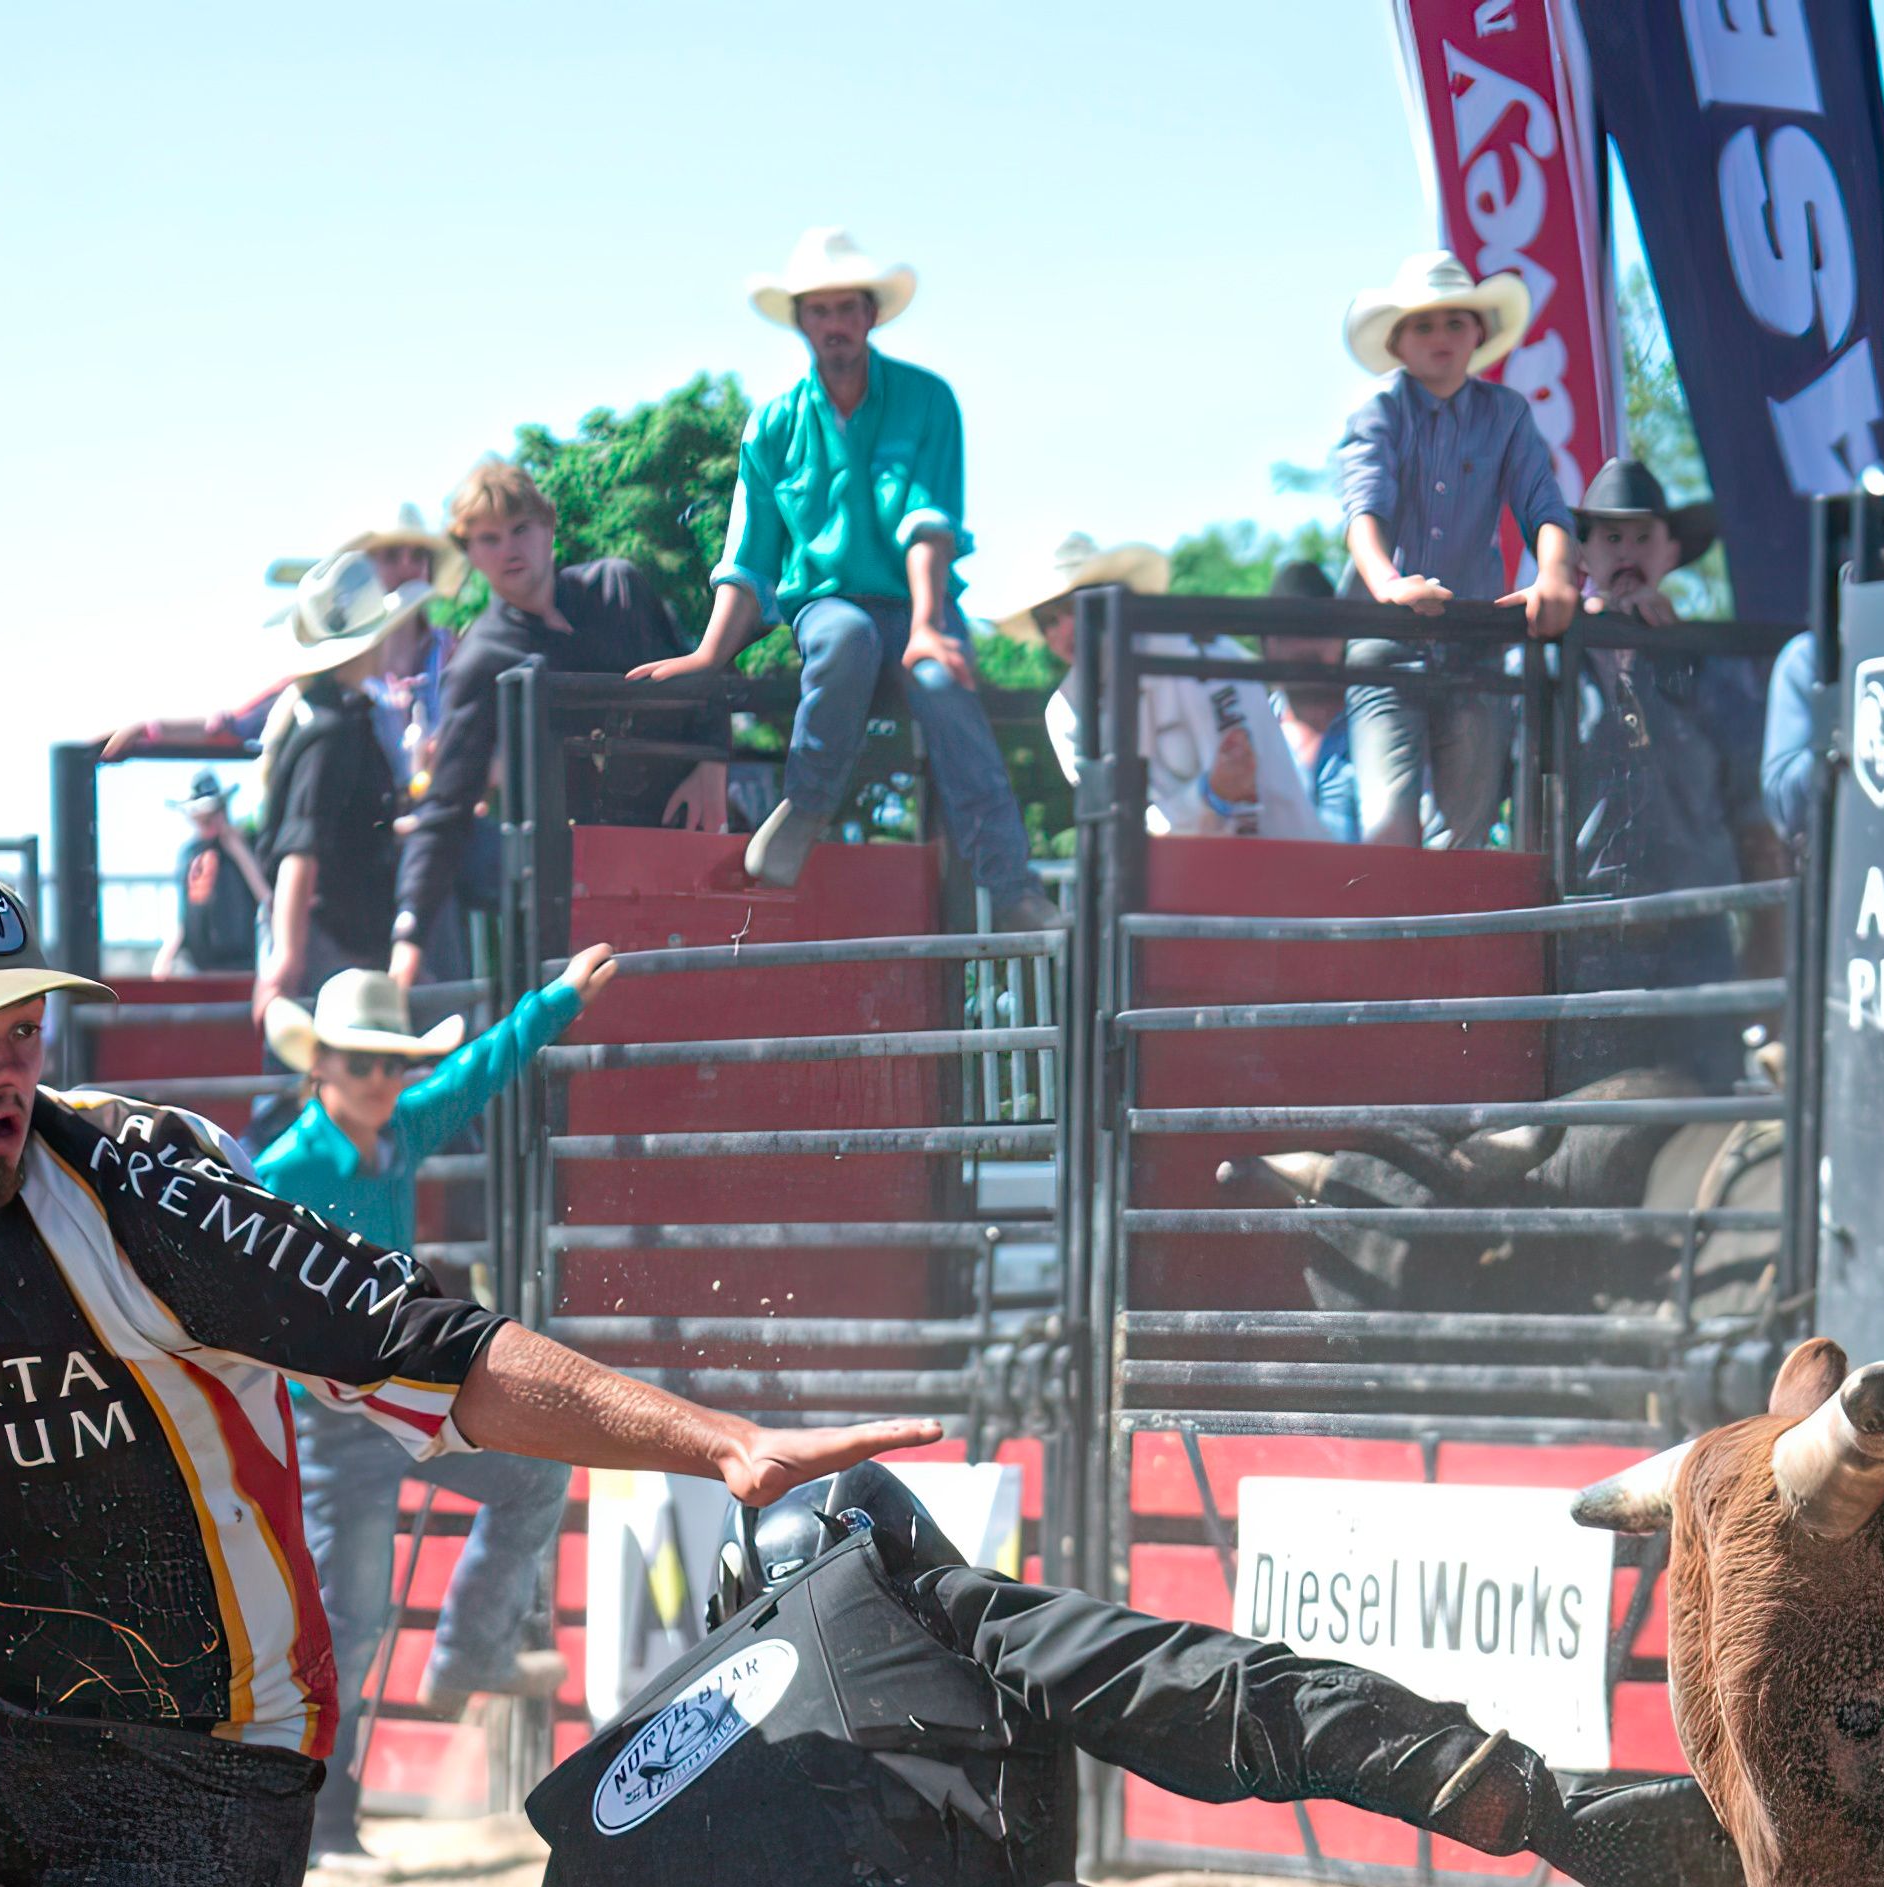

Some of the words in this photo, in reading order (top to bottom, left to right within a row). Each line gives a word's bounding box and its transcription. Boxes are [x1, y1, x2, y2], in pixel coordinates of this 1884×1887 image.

[1251, 1553, 1398, 1647] Diesel
[1419, 1561, 1582, 1660] Works
[614, 1702, 688, 1794] NORTH
